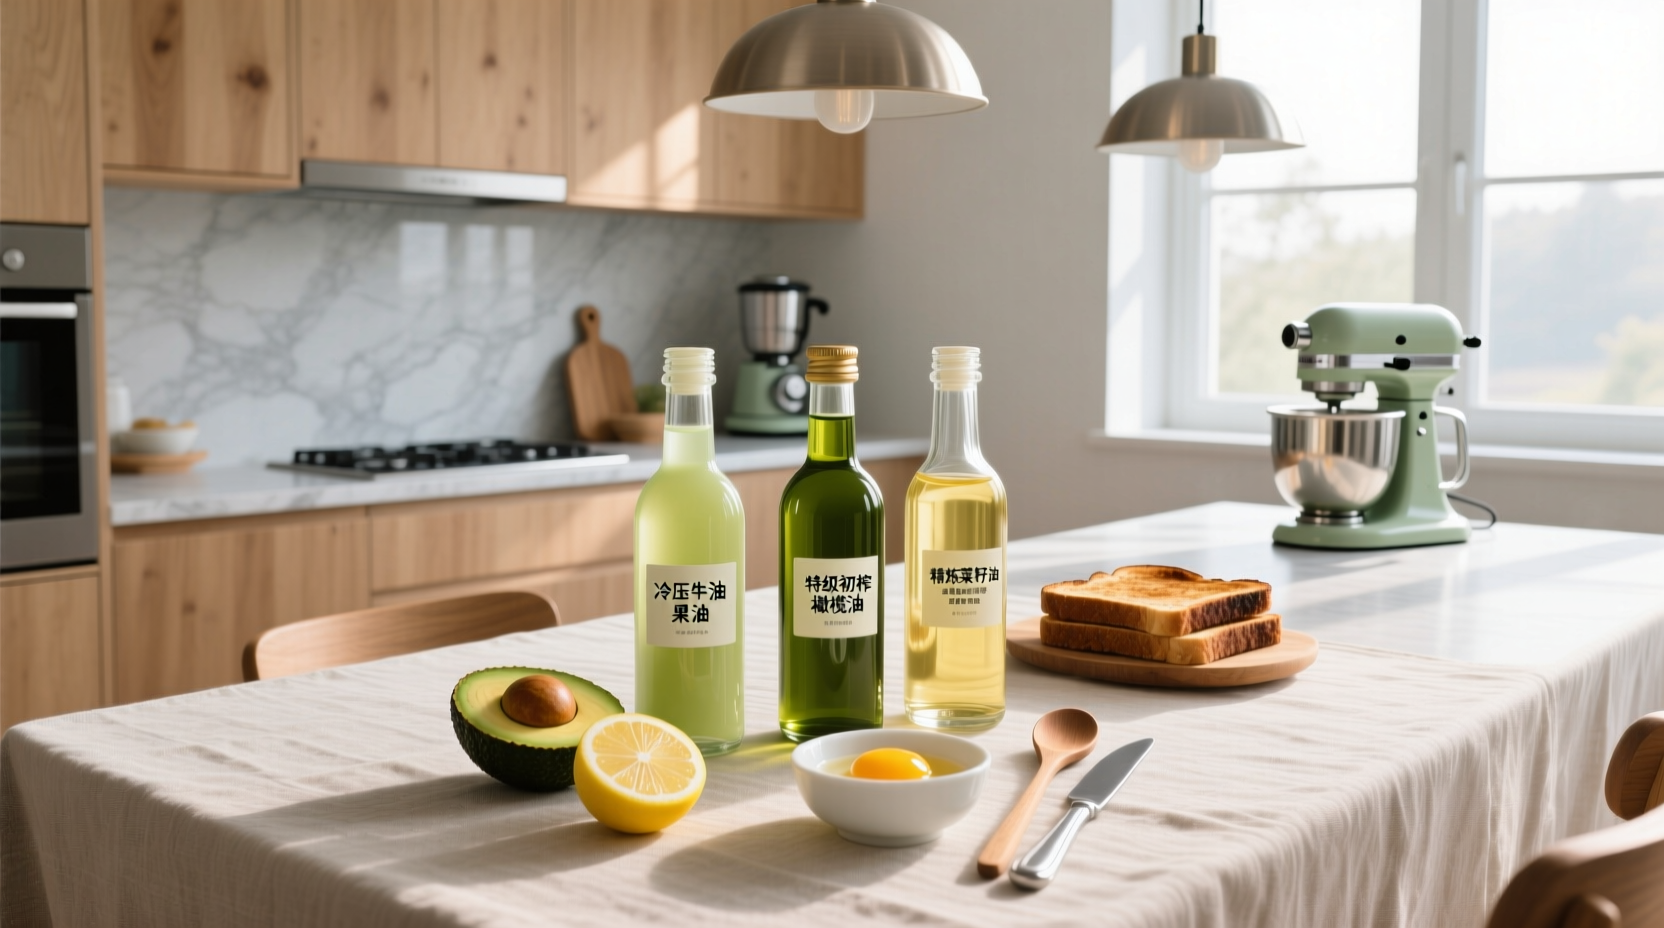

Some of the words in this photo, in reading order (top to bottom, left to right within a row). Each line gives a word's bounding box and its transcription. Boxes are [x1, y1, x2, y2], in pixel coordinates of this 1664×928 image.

[654, 579, 726, 600] 冷压牛油
[672, 604, 709, 623] 果油
